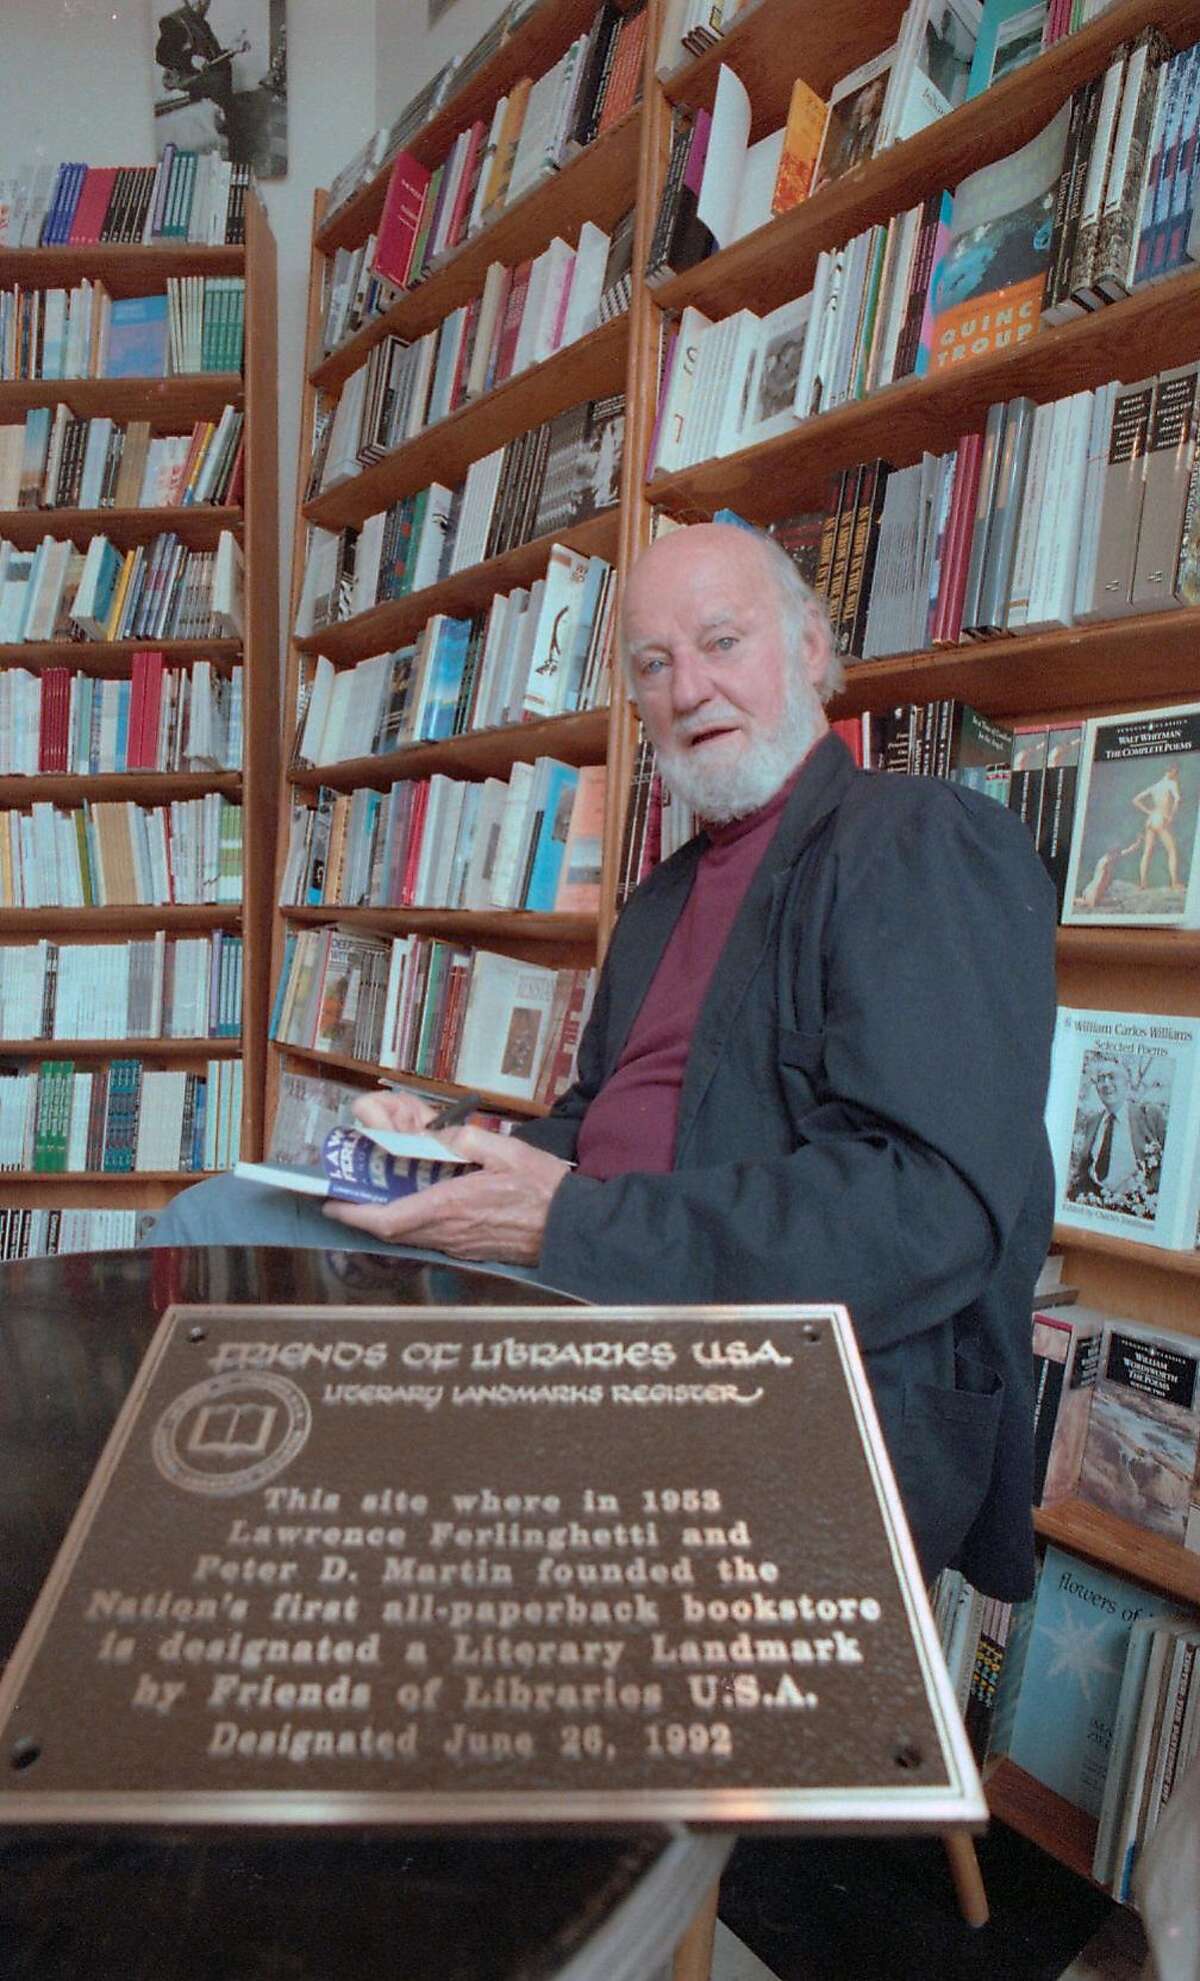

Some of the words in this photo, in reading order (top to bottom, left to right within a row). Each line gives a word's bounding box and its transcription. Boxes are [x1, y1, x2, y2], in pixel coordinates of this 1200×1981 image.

[1105, 749, 1121, 760] THE
[1121, 744, 1164, 757] COMPLETE
[1164, 740, 1193, 753] POEMS
[1118, 735, 1139, 745] WALT
[1140, 729, 1182, 742] WHITMAN
[1073, 1020, 1112, 1034] William
[1114, 1023, 1148, 1037] Carlos
[1150, 1025, 1193, 1042] Williams
[1137, 1043, 1168, 1057] Poems
[209, 1341, 388, 1370] FRIENDS
[402, 1342, 461, 1371] OF
[472, 1337, 678, 1369] LIBRARIES
[1134, 1352, 1168, 1371] WILLIAM
[323, 1384, 444, 1411] LITERARY
[453, 1384, 603, 1405] LANDMARKS
[612, 1384, 764, 1405] REGISTER
[264, 1488, 340, 1513] This
[362, 1488, 428, 1513] site
[452, 1489, 560, 1513] where
[583, 1489, 620, 1513] in
[642, 1489, 722, 1513] 1953
[228, 1519, 408, 1548] Lawrence
[430, 1521, 658, 1552] Ferlinghetti
[682, 1522, 752, 1547] and
[194, 1556, 298, 1584] Peter
[320, 1556, 358, 1583] D.
[383, 1558, 513, 1585] Martin
[537, 1557, 694, 1584] founded
[718, 1557, 779, 1584] the
[84, 1590, 249, 1622] Nation's
[271, 1592, 360, 1623] first
[382, 1594, 660, 1629] all-paperback
[684, 1593, 881, 1623] bookstore
[1058, 1571, 1117, 1616] flowers
[1121, 1607, 1142, 1627] of
[99, 1631, 137, 1663] is
[159, 1632, 381, 1669] designated
[405, 1640, 428, 1664] a
[453, 1634, 625, 1669] Literary
[652, 1632, 864, 1664] Landmark
[131, 1674, 186, 1714] by
[208, 1674, 373, 1708] Friends
[396, 1675, 443, 1706] of
[465, 1676, 663, 1708] Libraries
[687, 1674, 819, 1708] U.S.A.
[207, 1722, 419, 1761] Designated
[443, 1723, 534, 1759] June
[645, 1722, 733, 1759] 1992
